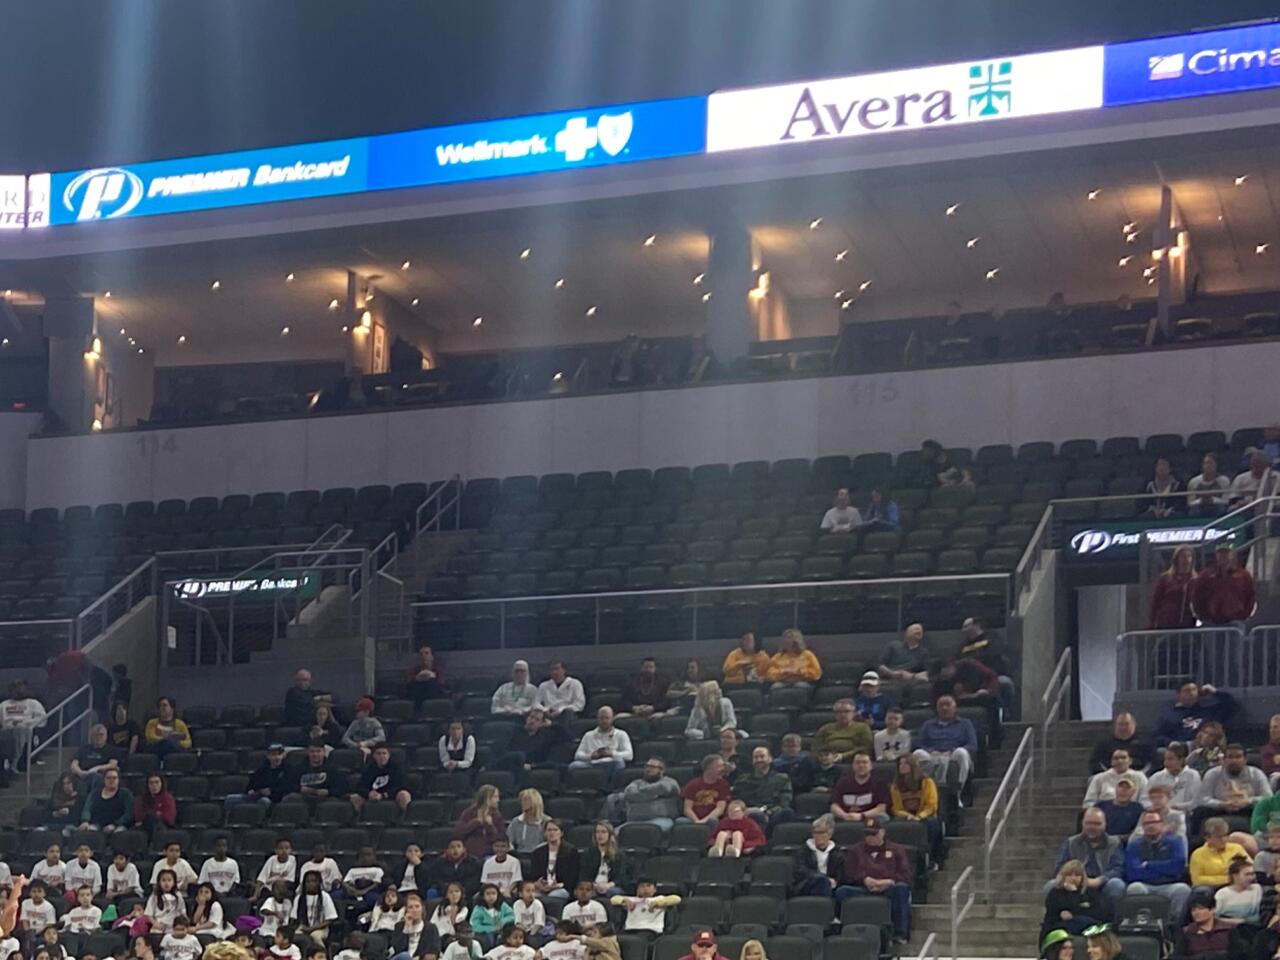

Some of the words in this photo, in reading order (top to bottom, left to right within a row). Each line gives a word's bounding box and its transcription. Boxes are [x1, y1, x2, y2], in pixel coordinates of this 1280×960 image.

[779, 86, 957, 141] Avera
[147, 167, 251, 198] PREMIER
[252, 154, 351, 187] Bankcard
[1111, 533, 1140, 545] First
[1146, 529, 1204, 543] PREMIER
